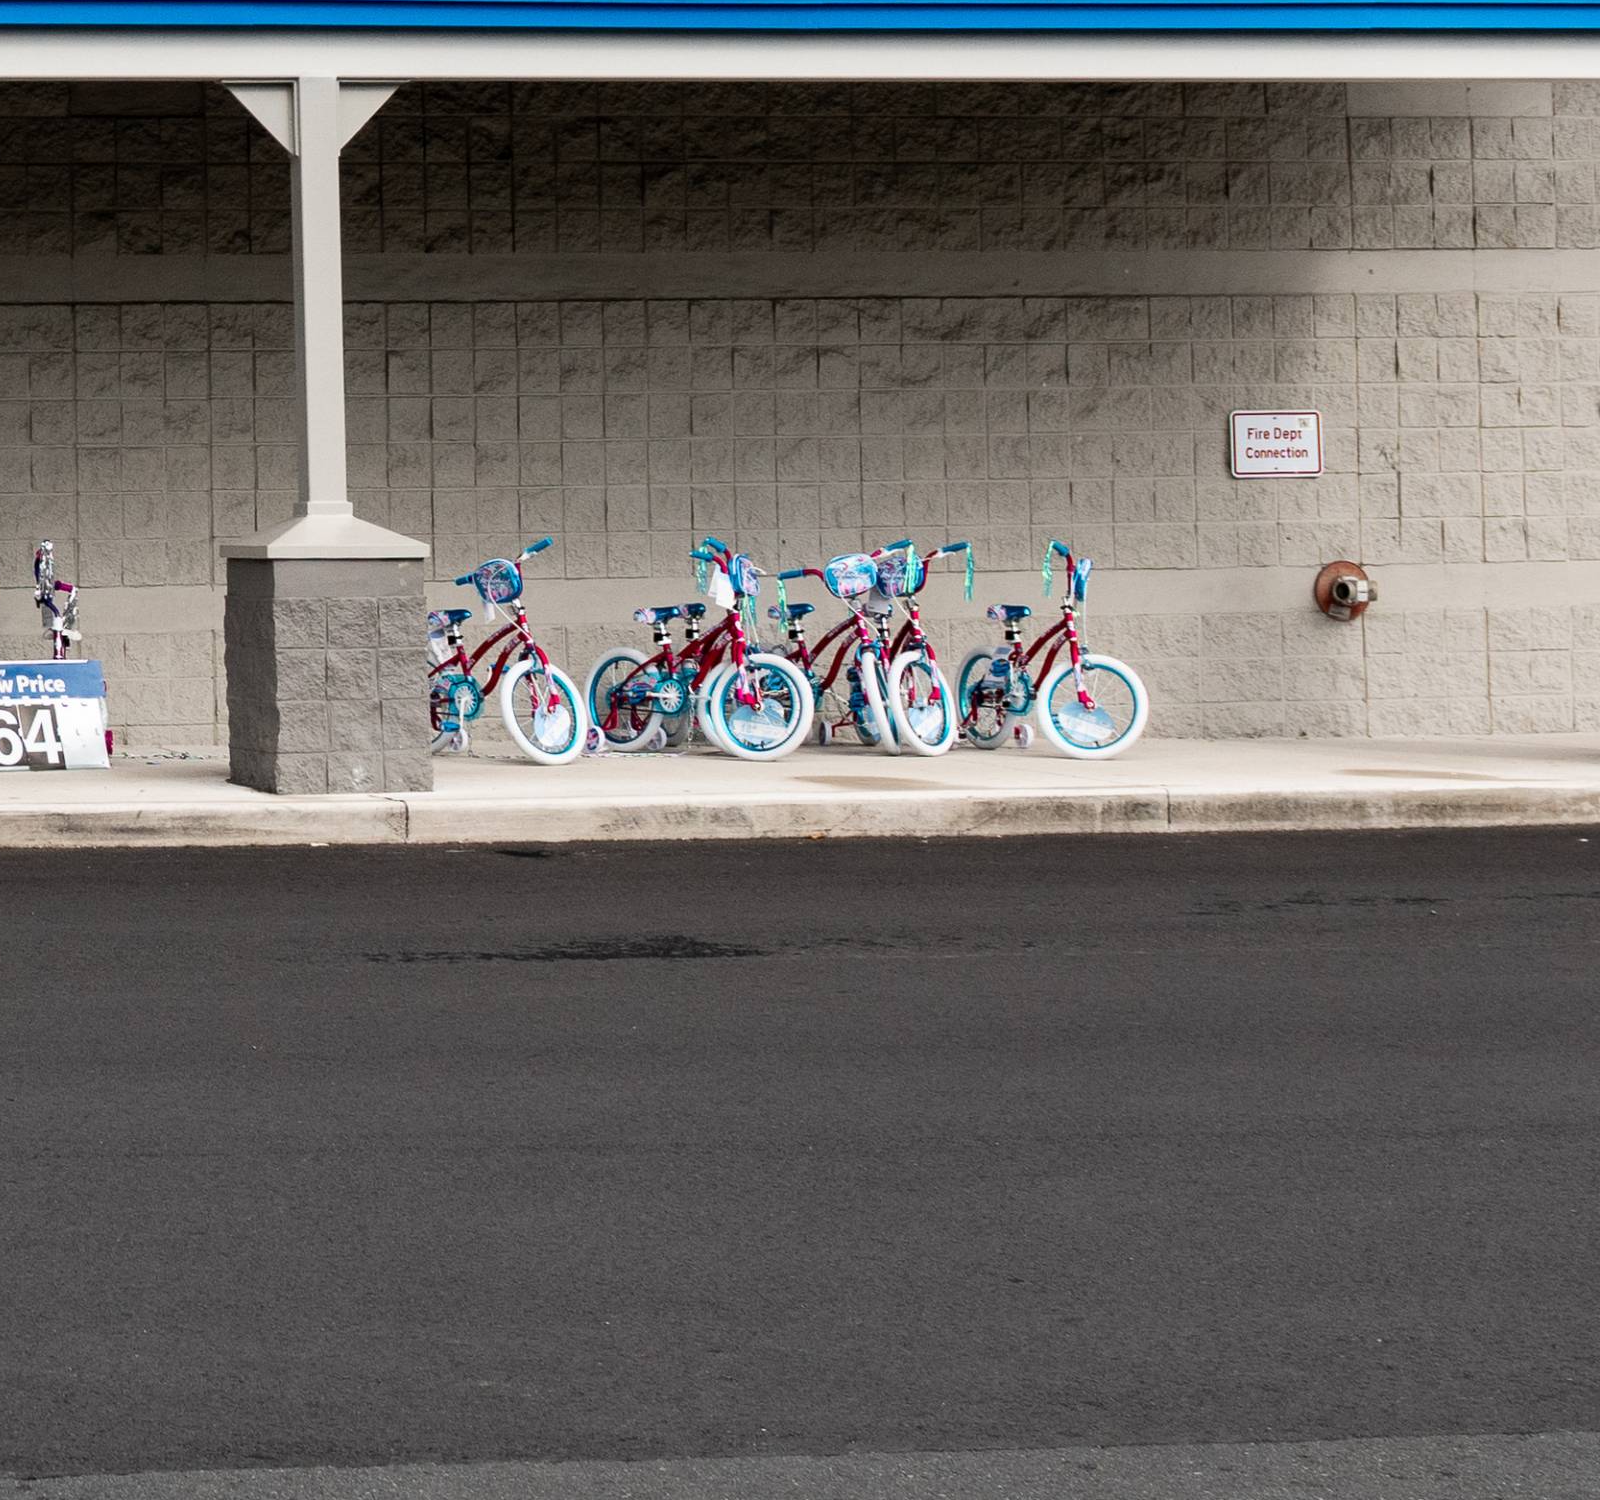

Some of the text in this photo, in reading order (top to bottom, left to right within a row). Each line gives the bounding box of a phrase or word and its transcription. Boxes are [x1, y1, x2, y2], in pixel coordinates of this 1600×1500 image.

[1247, 427, 1302, 441] Fire Dept
[1246, 447, 1308, 458] Connection
[16, 674, 66, 693] Price
